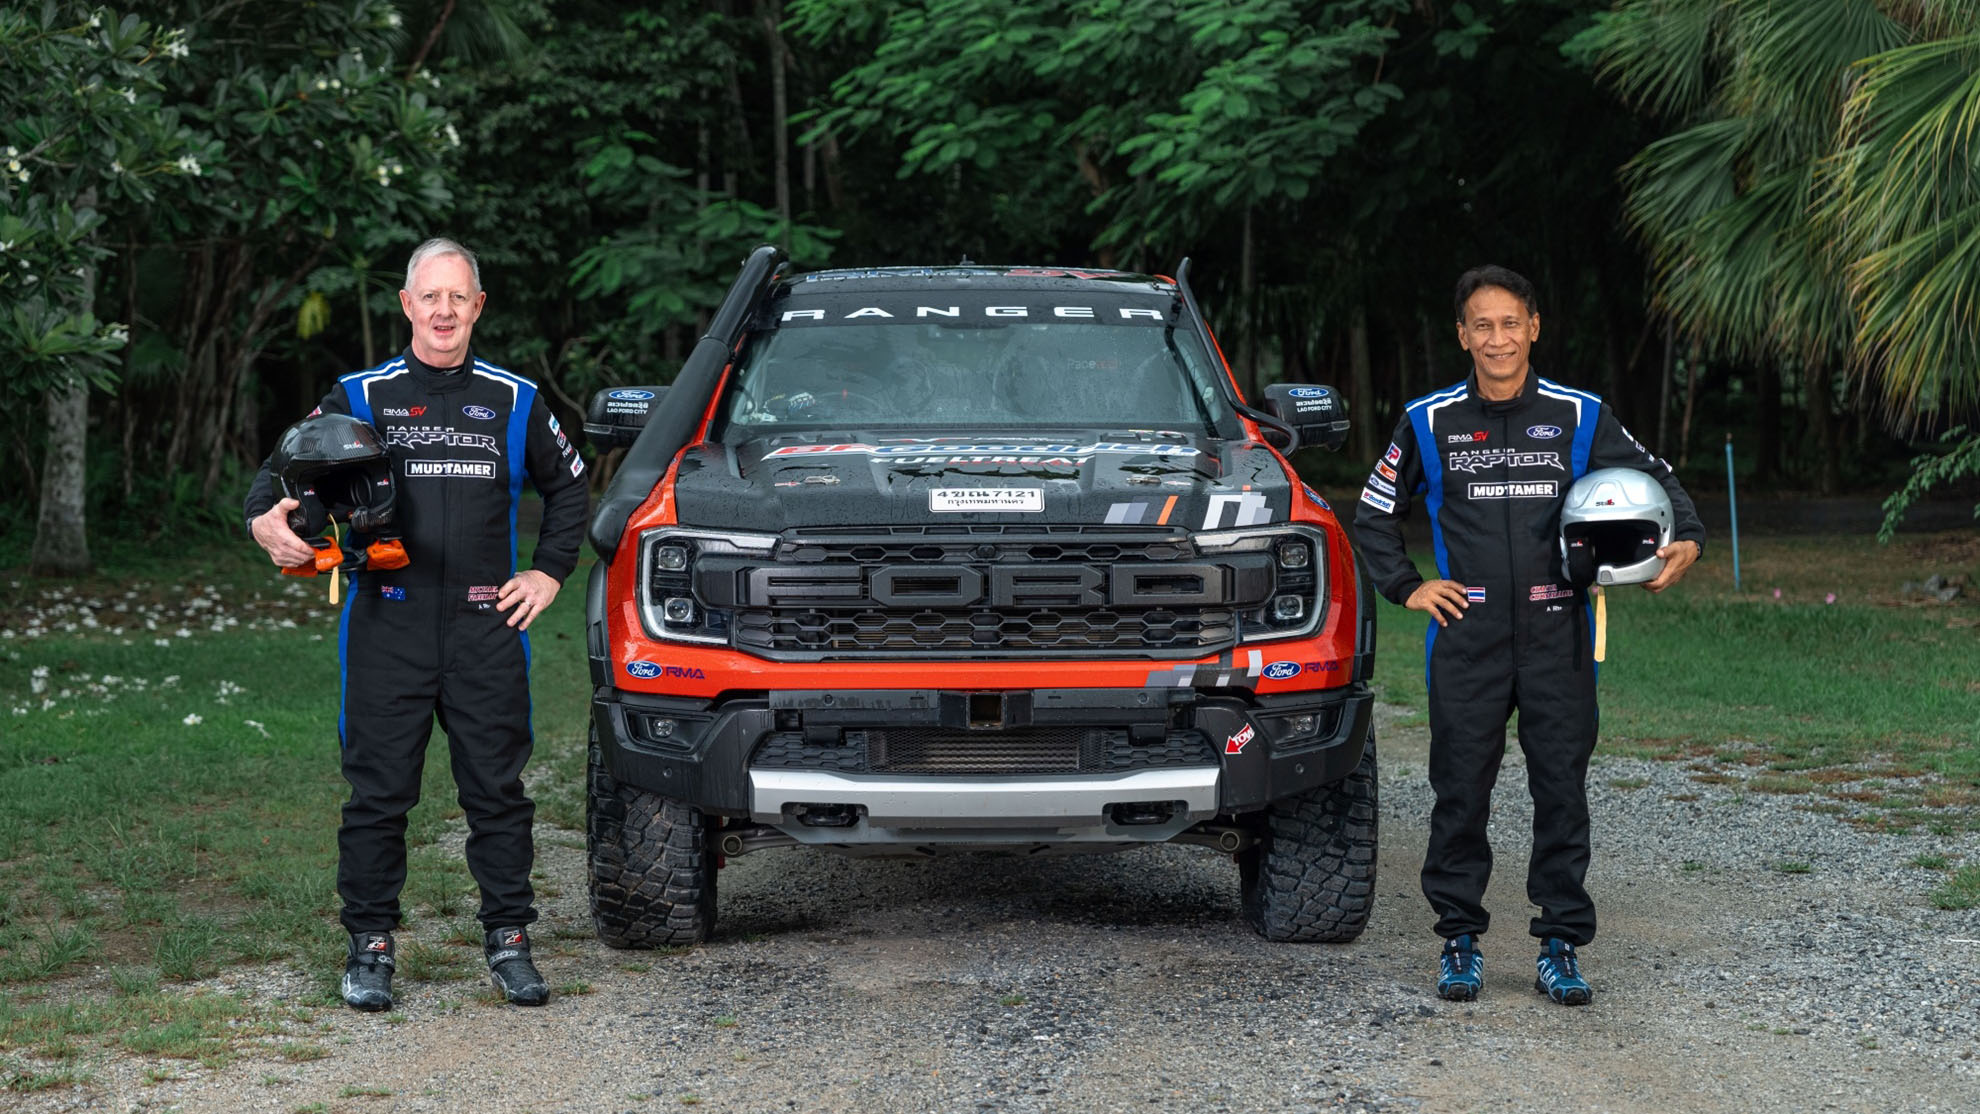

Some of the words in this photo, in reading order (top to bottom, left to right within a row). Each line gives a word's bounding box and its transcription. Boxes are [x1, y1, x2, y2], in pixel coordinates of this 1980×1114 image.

[781, 306, 1164, 321] RANGER
[1530, 425, 1557, 438] Ford
[386, 431, 500, 456] RAPTOR
[1449, 452, 1565, 474] RAPTOR
[742, 564, 1227, 607] FORD
[630, 661, 657, 677] Ford
[666, 666, 705, 679] RMA
[1267, 661, 1296, 677] Ford
[1304, 661, 1339, 673] RMA
[1231, 728, 1255, 746] TOW
